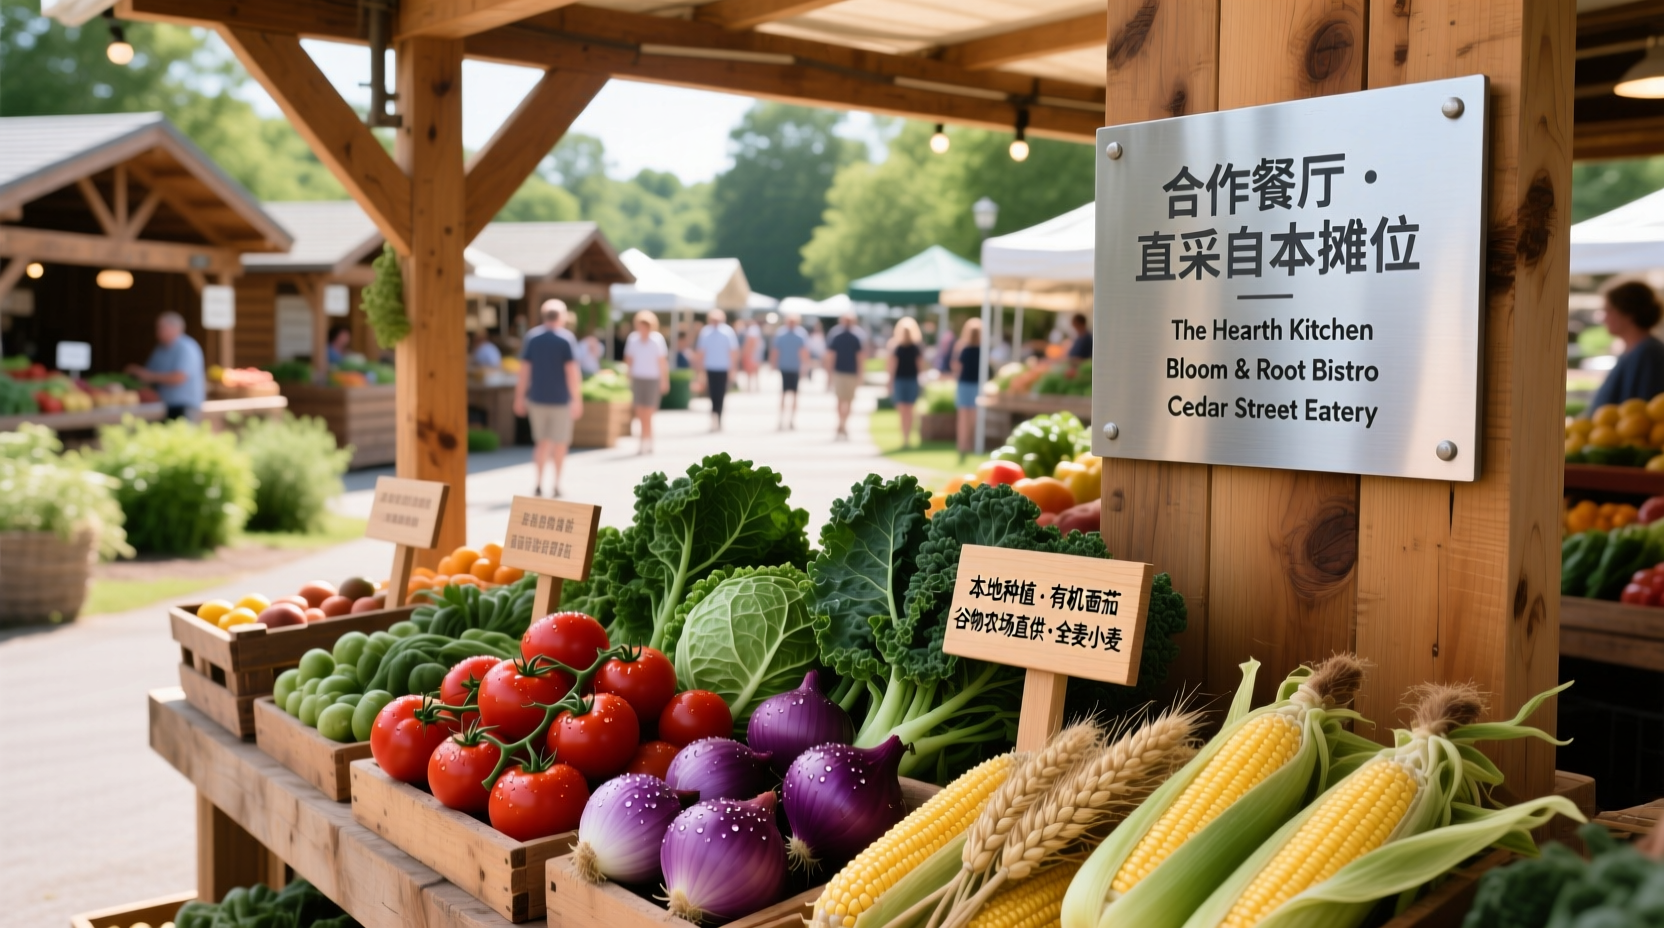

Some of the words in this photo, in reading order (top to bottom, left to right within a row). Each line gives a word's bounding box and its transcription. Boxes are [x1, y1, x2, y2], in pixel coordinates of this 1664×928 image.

[1135, 214, 1420, 282] 直采自本摊位
[1171, 319, 1207, 341] The
[1212, 318, 1283, 341] Hearth
[1289, 317, 1374, 341] Kitchen
[1166, 357, 1228, 380] Bloom
[1234, 359, 1250, 380] &
[1256, 359, 1306, 381] Root
[1312, 359, 1379, 382] Bistro
[1167, 395, 1228, 418] Cedar
[1234, 397, 1298, 421] Street
[1304, 399, 1378, 429] Eatery
